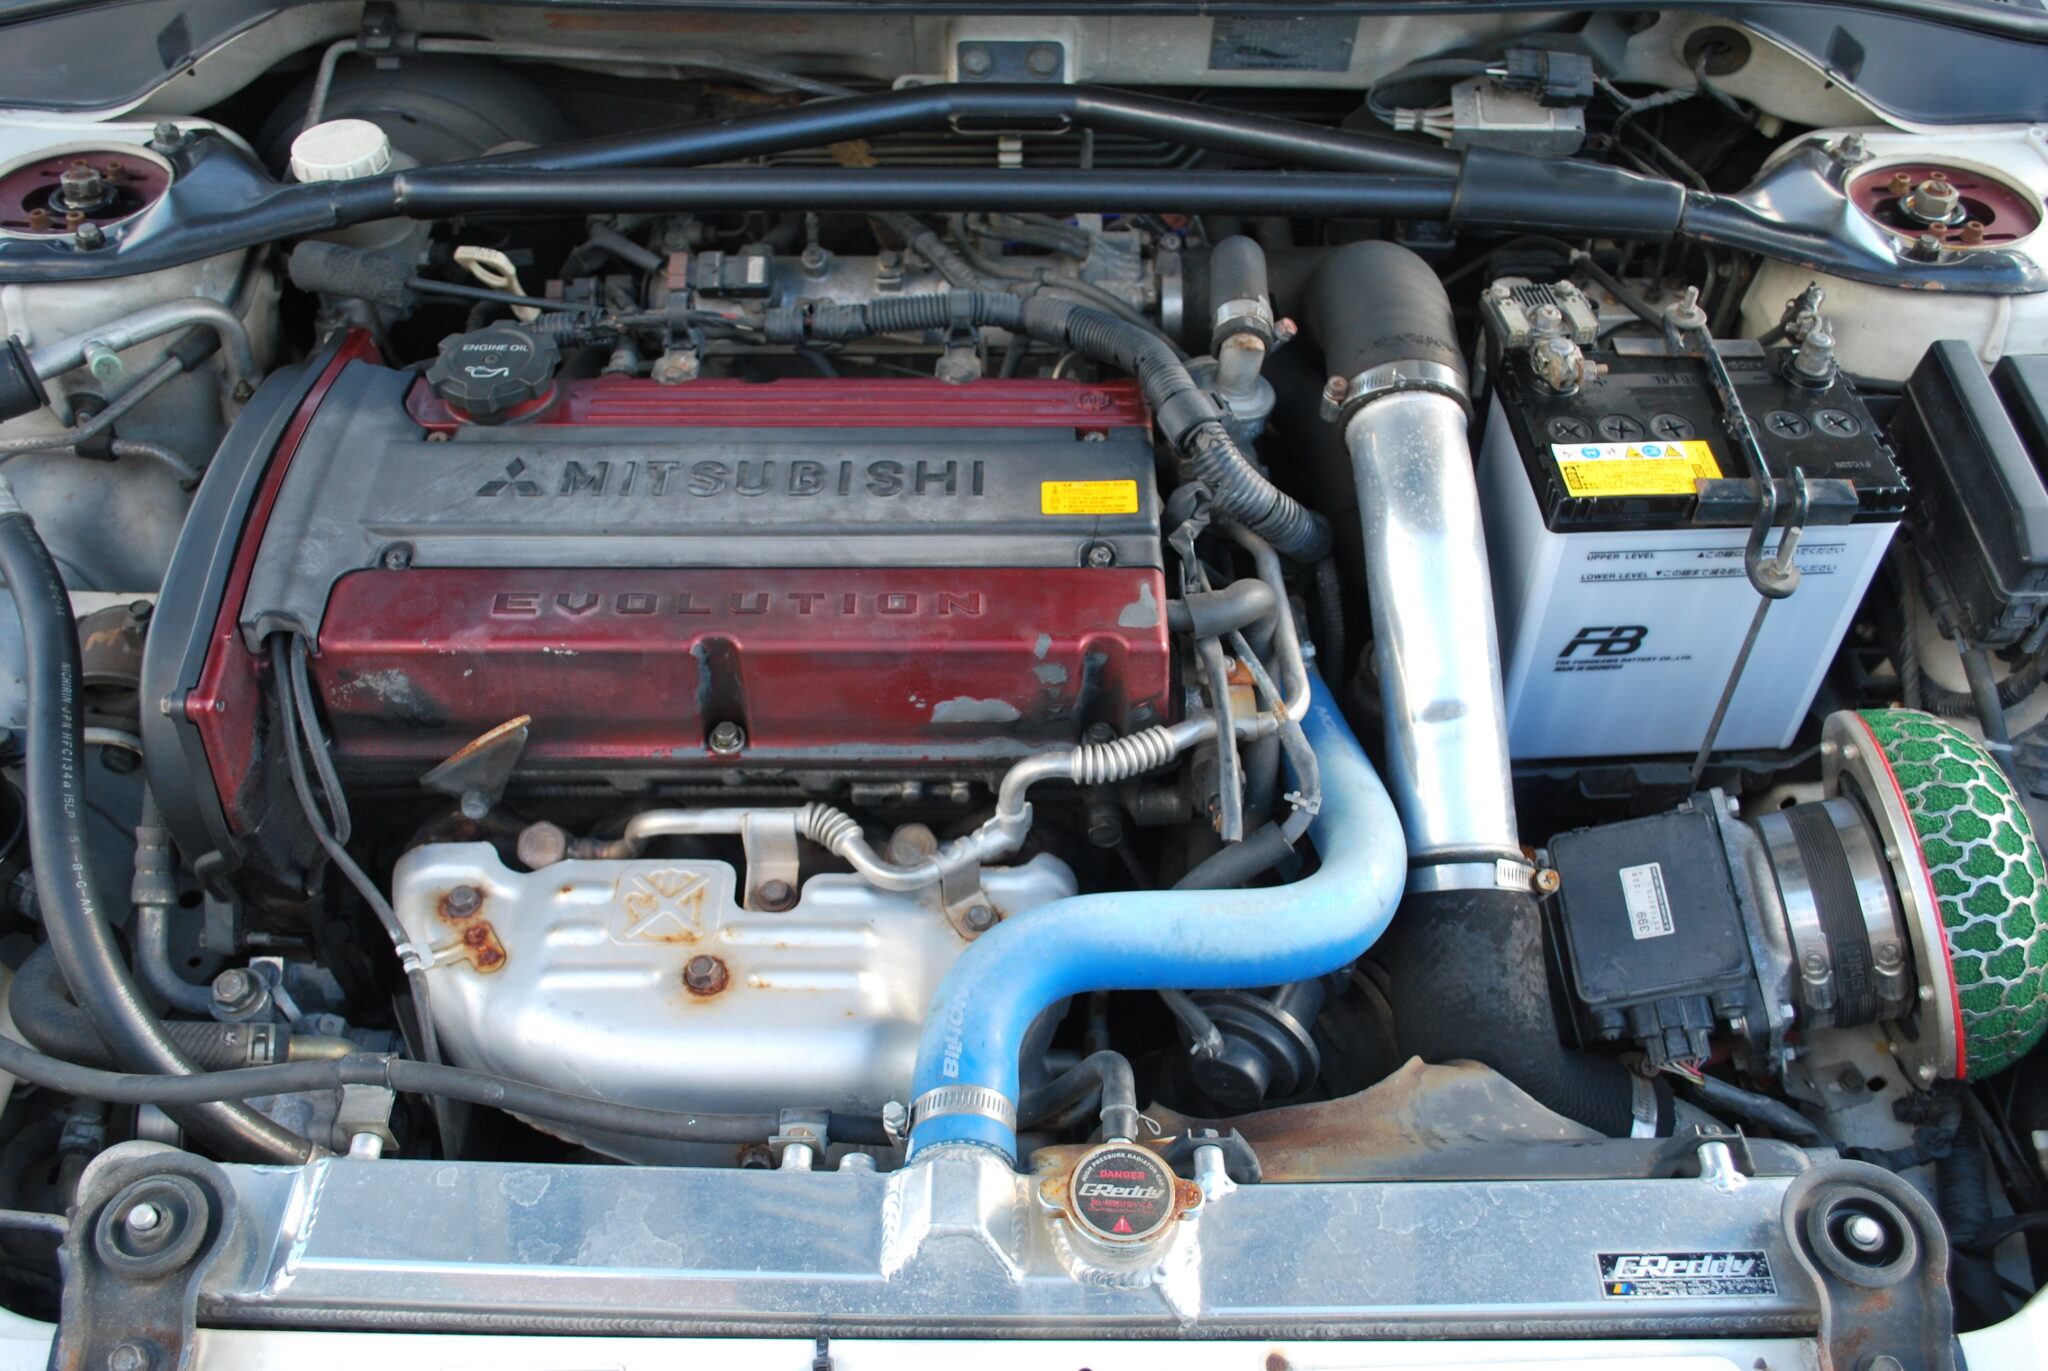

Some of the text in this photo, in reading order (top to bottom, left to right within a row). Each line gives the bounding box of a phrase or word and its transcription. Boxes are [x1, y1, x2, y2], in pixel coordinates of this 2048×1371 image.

[462, 344, 529, 352] ENGINE OIL
[557, 459, 985, 497] MITSUBISHI
[1587, 551, 1656, 561] UPPER LEVEL
[1580, 571, 1649, 581] LOWER LEVEL
[490, 592, 986, 616] EVOLUTION
[1557, 624, 1649, 658] FB
[61, 662, 73, 703] NICHIRIN
[62, 706, 73, 729] JPN
[1636, 911, 1650, 932] 399
[1091, 1152, 1126, 1168] PRESSURE
[1126, 1153, 1158, 1175] RADIATOR
[1099, 1170, 1146, 1180] DANGER
[1078, 1183, 1166, 1199] GReddy
[1613, 1255, 1756, 1277] GReddy
